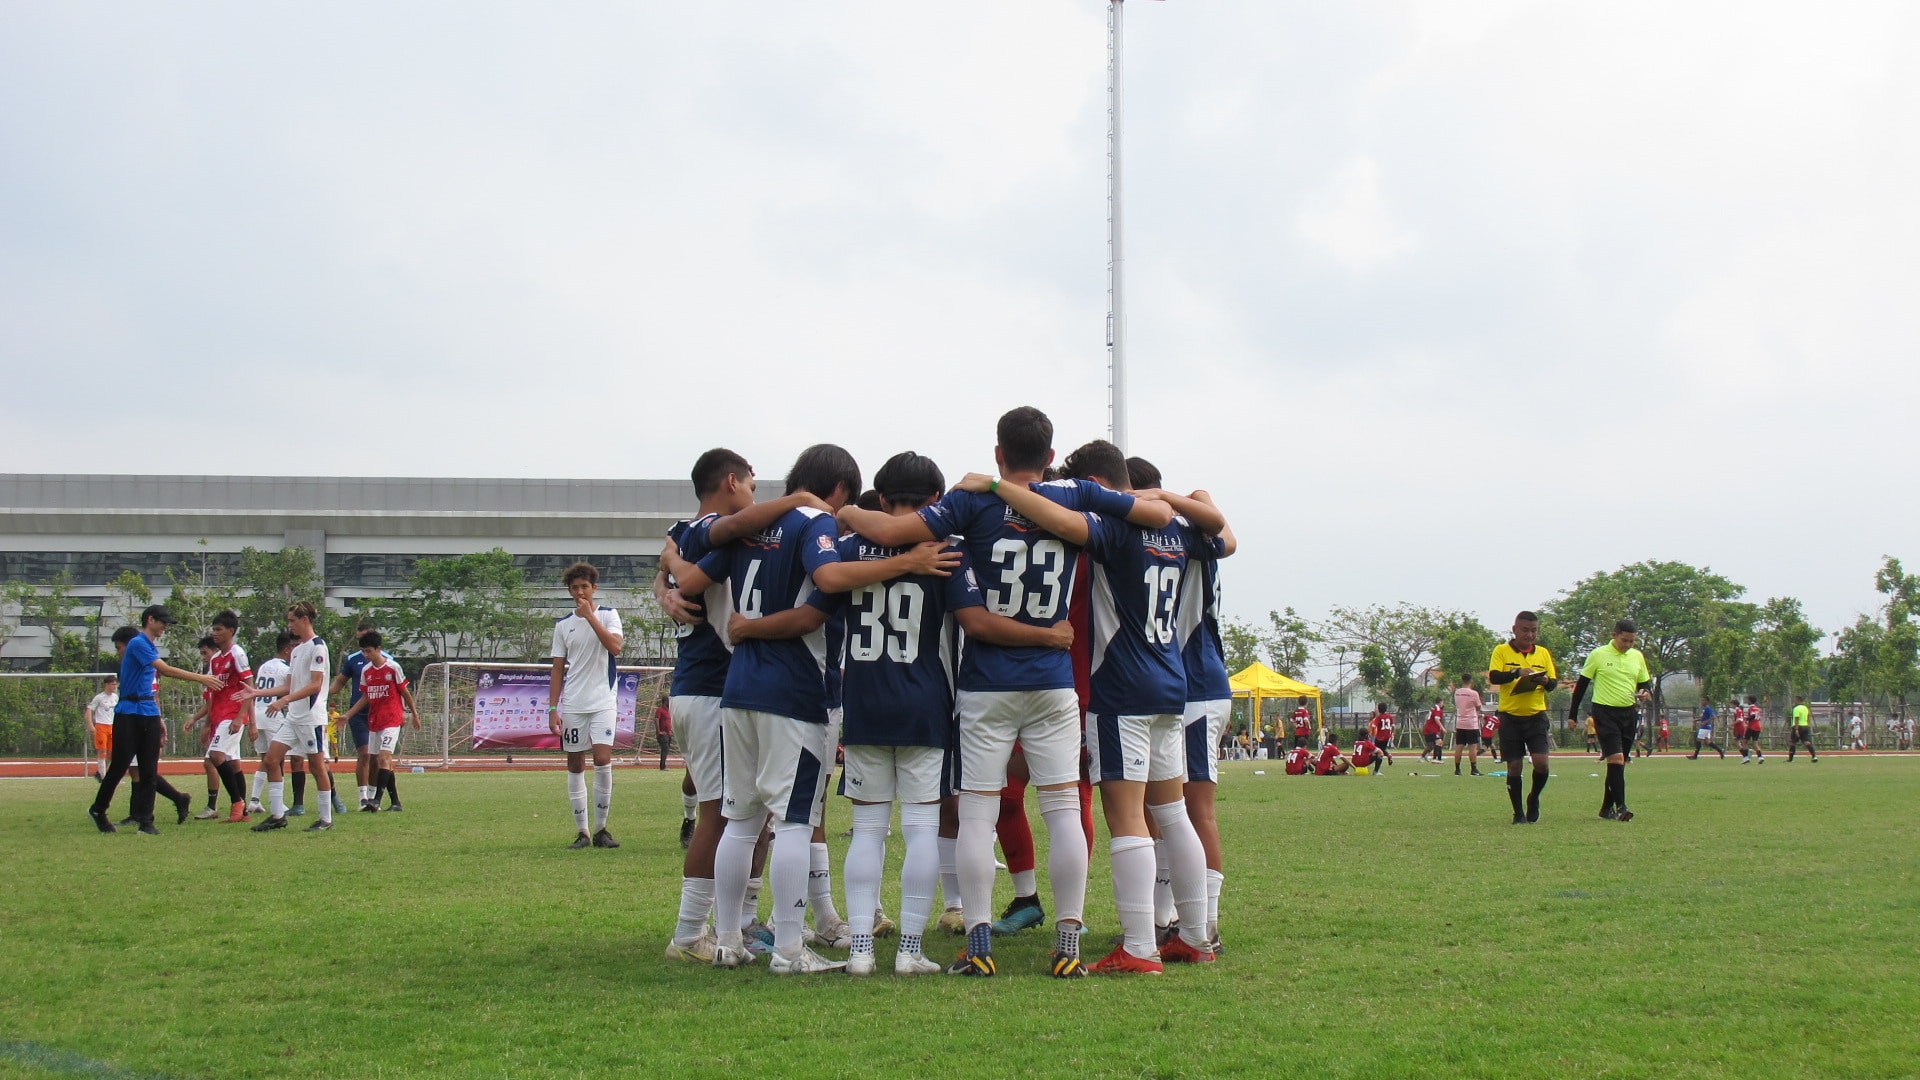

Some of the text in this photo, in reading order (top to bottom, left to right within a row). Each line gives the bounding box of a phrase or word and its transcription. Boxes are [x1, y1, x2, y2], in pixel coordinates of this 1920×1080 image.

[859, 545, 900, 557] Briti
[986, 538, 1064, 618] 33
[739, 559, 763, 619] 4
[1144, 565, 1180, 643] 13
[851, 581, 924, 664] 39
[498, 674, 523, 682] Bangkok
[1485, 720, 1495, 731] 21
[382, 736, 392, 745] 27
[564, 728, 579, 744] 48
[1133, 758, 1145, 766] Ari
[851, 778, 863, 787] Ari
